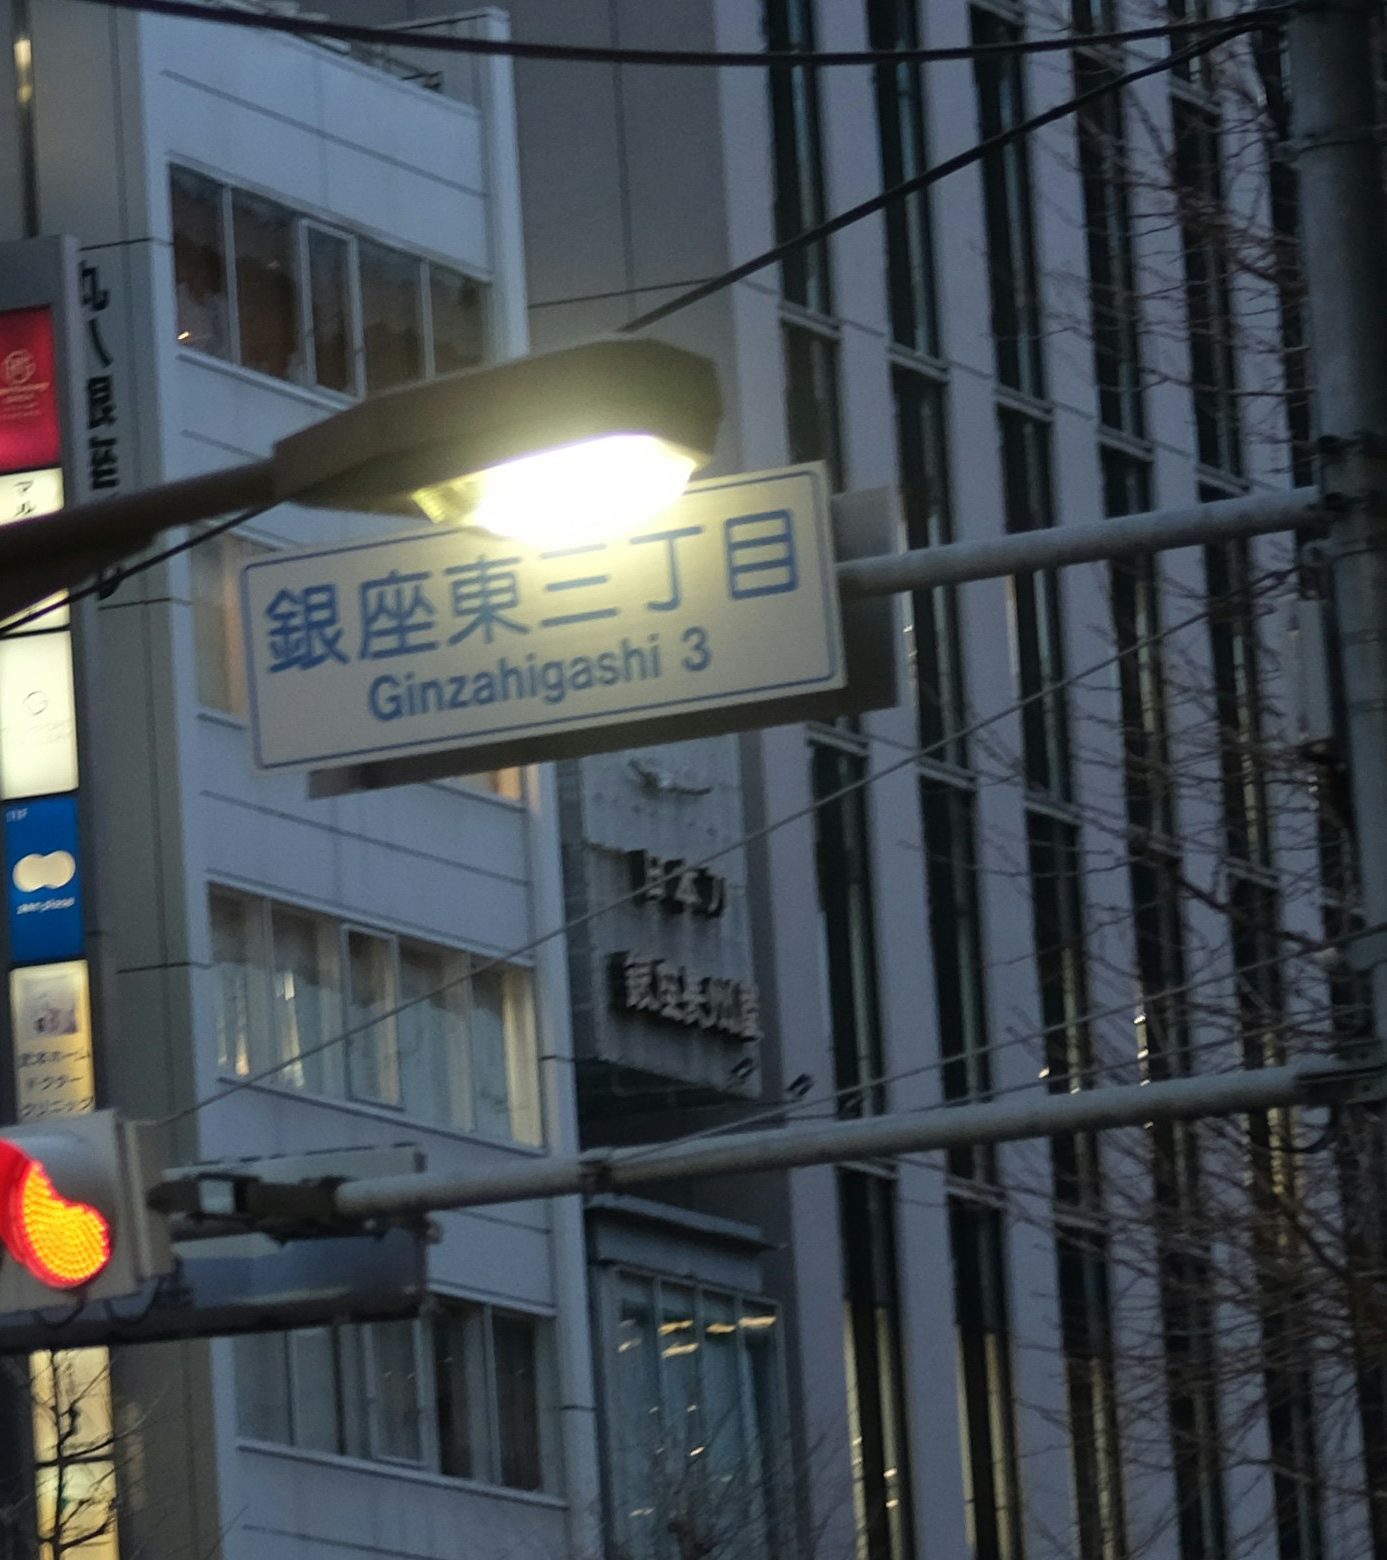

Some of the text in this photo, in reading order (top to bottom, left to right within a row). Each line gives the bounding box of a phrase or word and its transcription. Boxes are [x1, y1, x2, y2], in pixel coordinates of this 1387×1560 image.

[265, 506, 801, 675] 銀座東三丁目
[367, 625, 712, 723] Ginzahigashi 3
[639, 852, 727, 918] 日本刀
